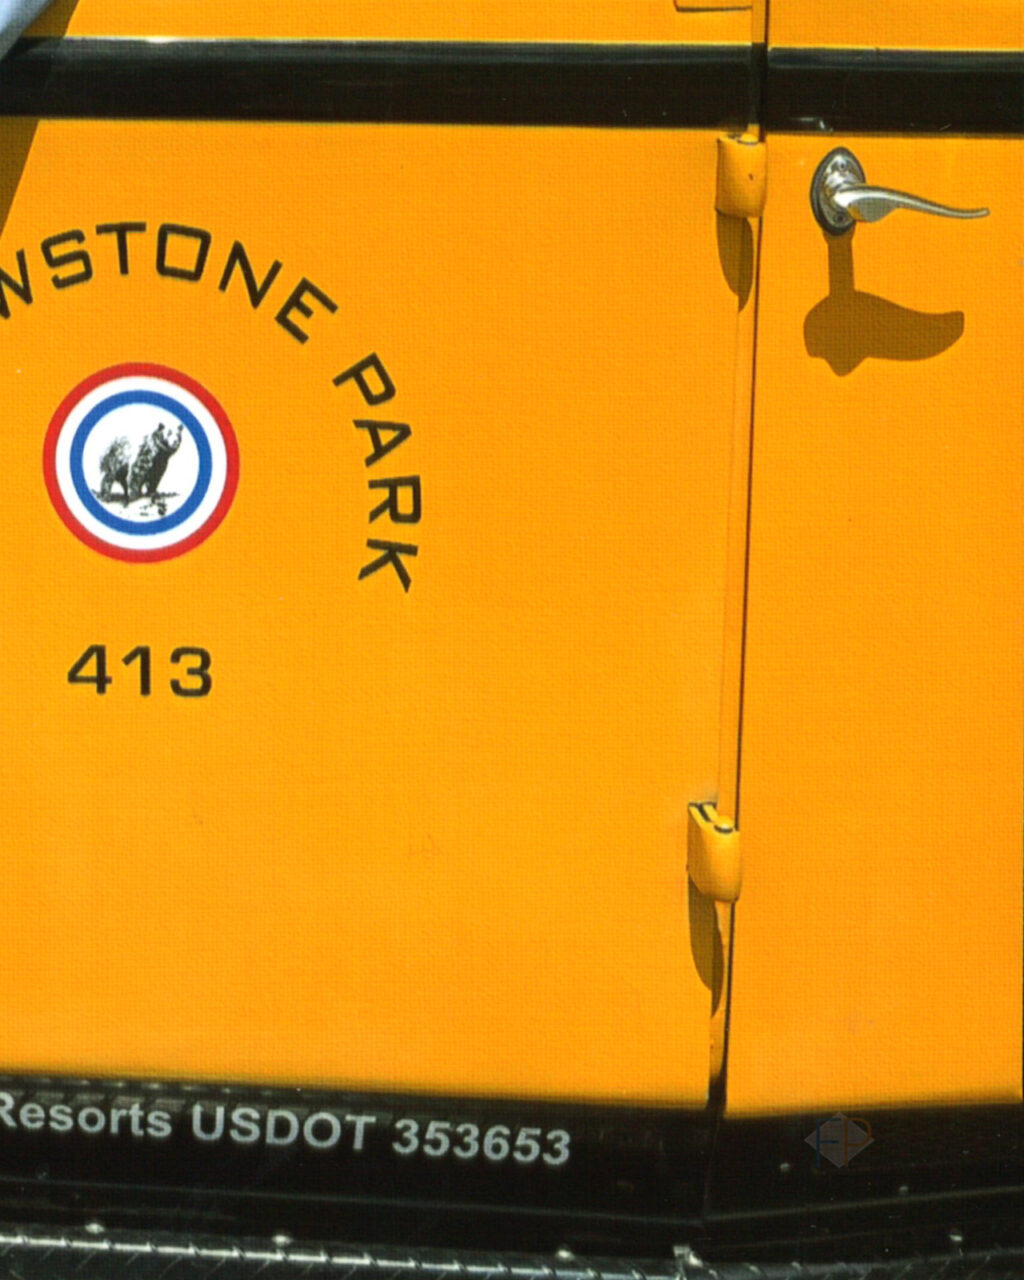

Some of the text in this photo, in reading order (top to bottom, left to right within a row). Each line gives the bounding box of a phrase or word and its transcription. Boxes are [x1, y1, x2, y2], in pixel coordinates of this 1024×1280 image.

[332, 352, 422, 592] PARK
[67, 645, 212, 697] 413
[191, 1101, 377, 1150] USDOT
[391, 1117, 572, 1166] 353653
